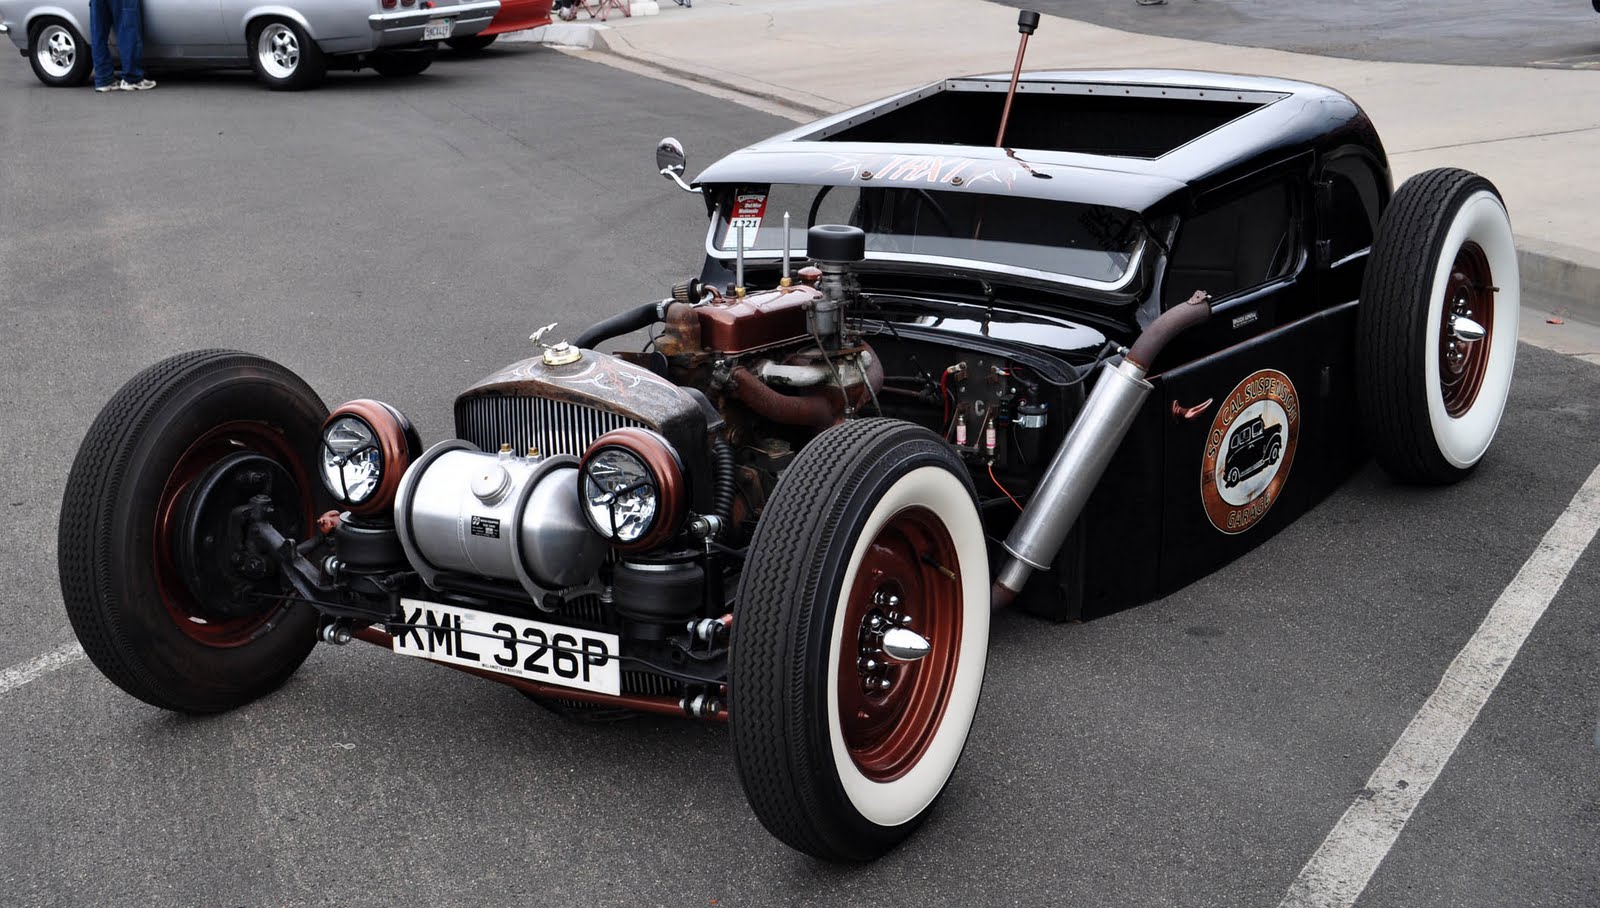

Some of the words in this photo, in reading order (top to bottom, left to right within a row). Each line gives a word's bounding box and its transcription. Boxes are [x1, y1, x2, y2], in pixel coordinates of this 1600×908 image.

[1222, 393, 1244, 425] CAL
[1245, 377, 1297, 424] SUSPENSION
[1227, 489, 1271, 529] GARAGE
[400, 605, 480, 661] KML
[492, 622, 609, 682] 326P
